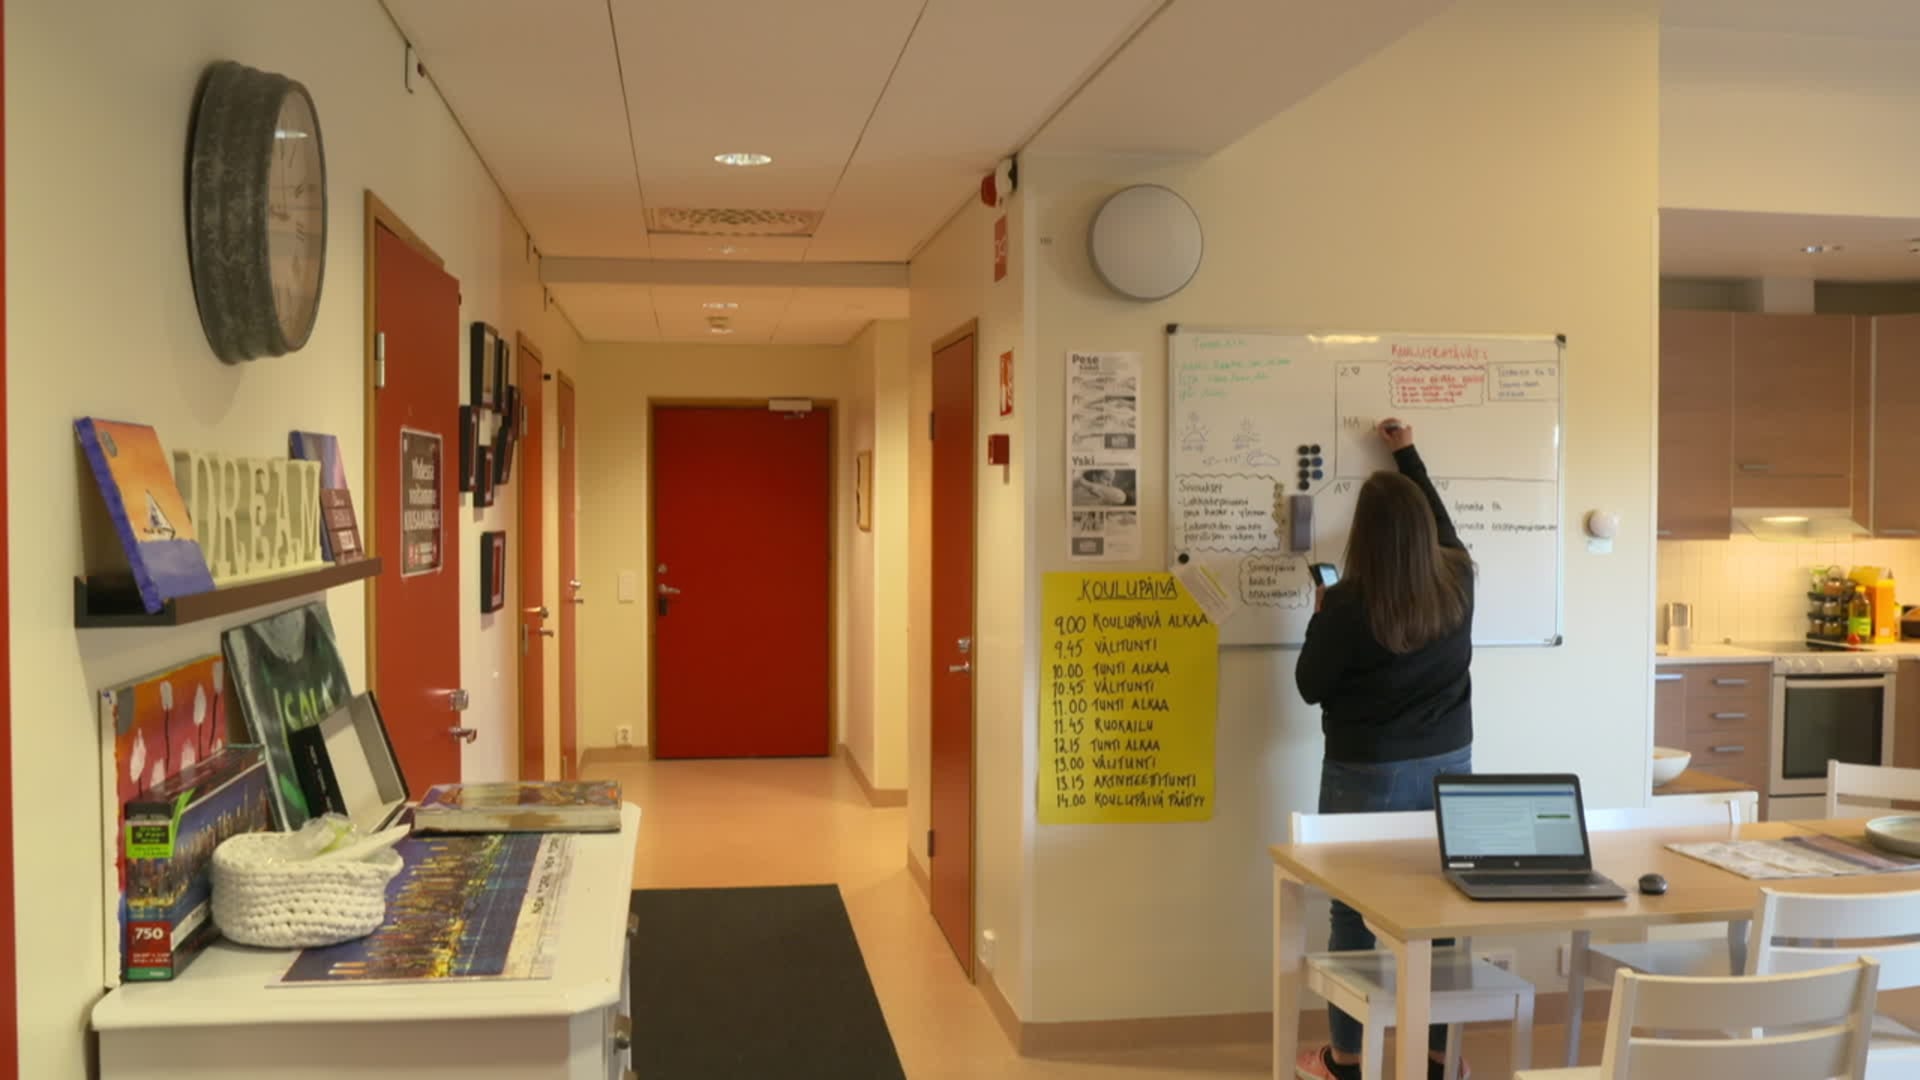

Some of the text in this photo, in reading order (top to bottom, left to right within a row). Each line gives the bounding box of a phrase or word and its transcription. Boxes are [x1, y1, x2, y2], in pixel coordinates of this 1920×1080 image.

[1072, 354, 1098, 364] Pese
[1072, 456, 1095, 466] Yski
[178, 450, 321, 579] DREAM
[1080, 575, 1177, 602] KOULUPÄIVÄ
[1093, 611, 1162, 632] KOULUPÄIVÄ
[1168, 613, 1208, 628] ALKAA
[1054, 636, 1159, 659] 9.45 VÄLITUNTI
[1053, 661, 1170, 678] 10.00 TUNTI ALKAA
[1052, 678, 1155, 698] 10.45 VÄLITUNTI
[1053, 699, 1169, 716] 11.00 TUNTI ALKAA
[1054, 718, 1153, 735] 11.45 RUOKAILU
[1054, 738, 1160, 754] 12.15 TUNTI ALKAA
[1055, 755, 1156, 773] 13.00 VÄLITUNTI
[1056, 776, 1084, 790] 13.15
[1057, 794, 1086, 808] 14.00
[1094, 791, 1164, 808] KOULUPÄIVÄ
[135, 928, 163, 939] 750
